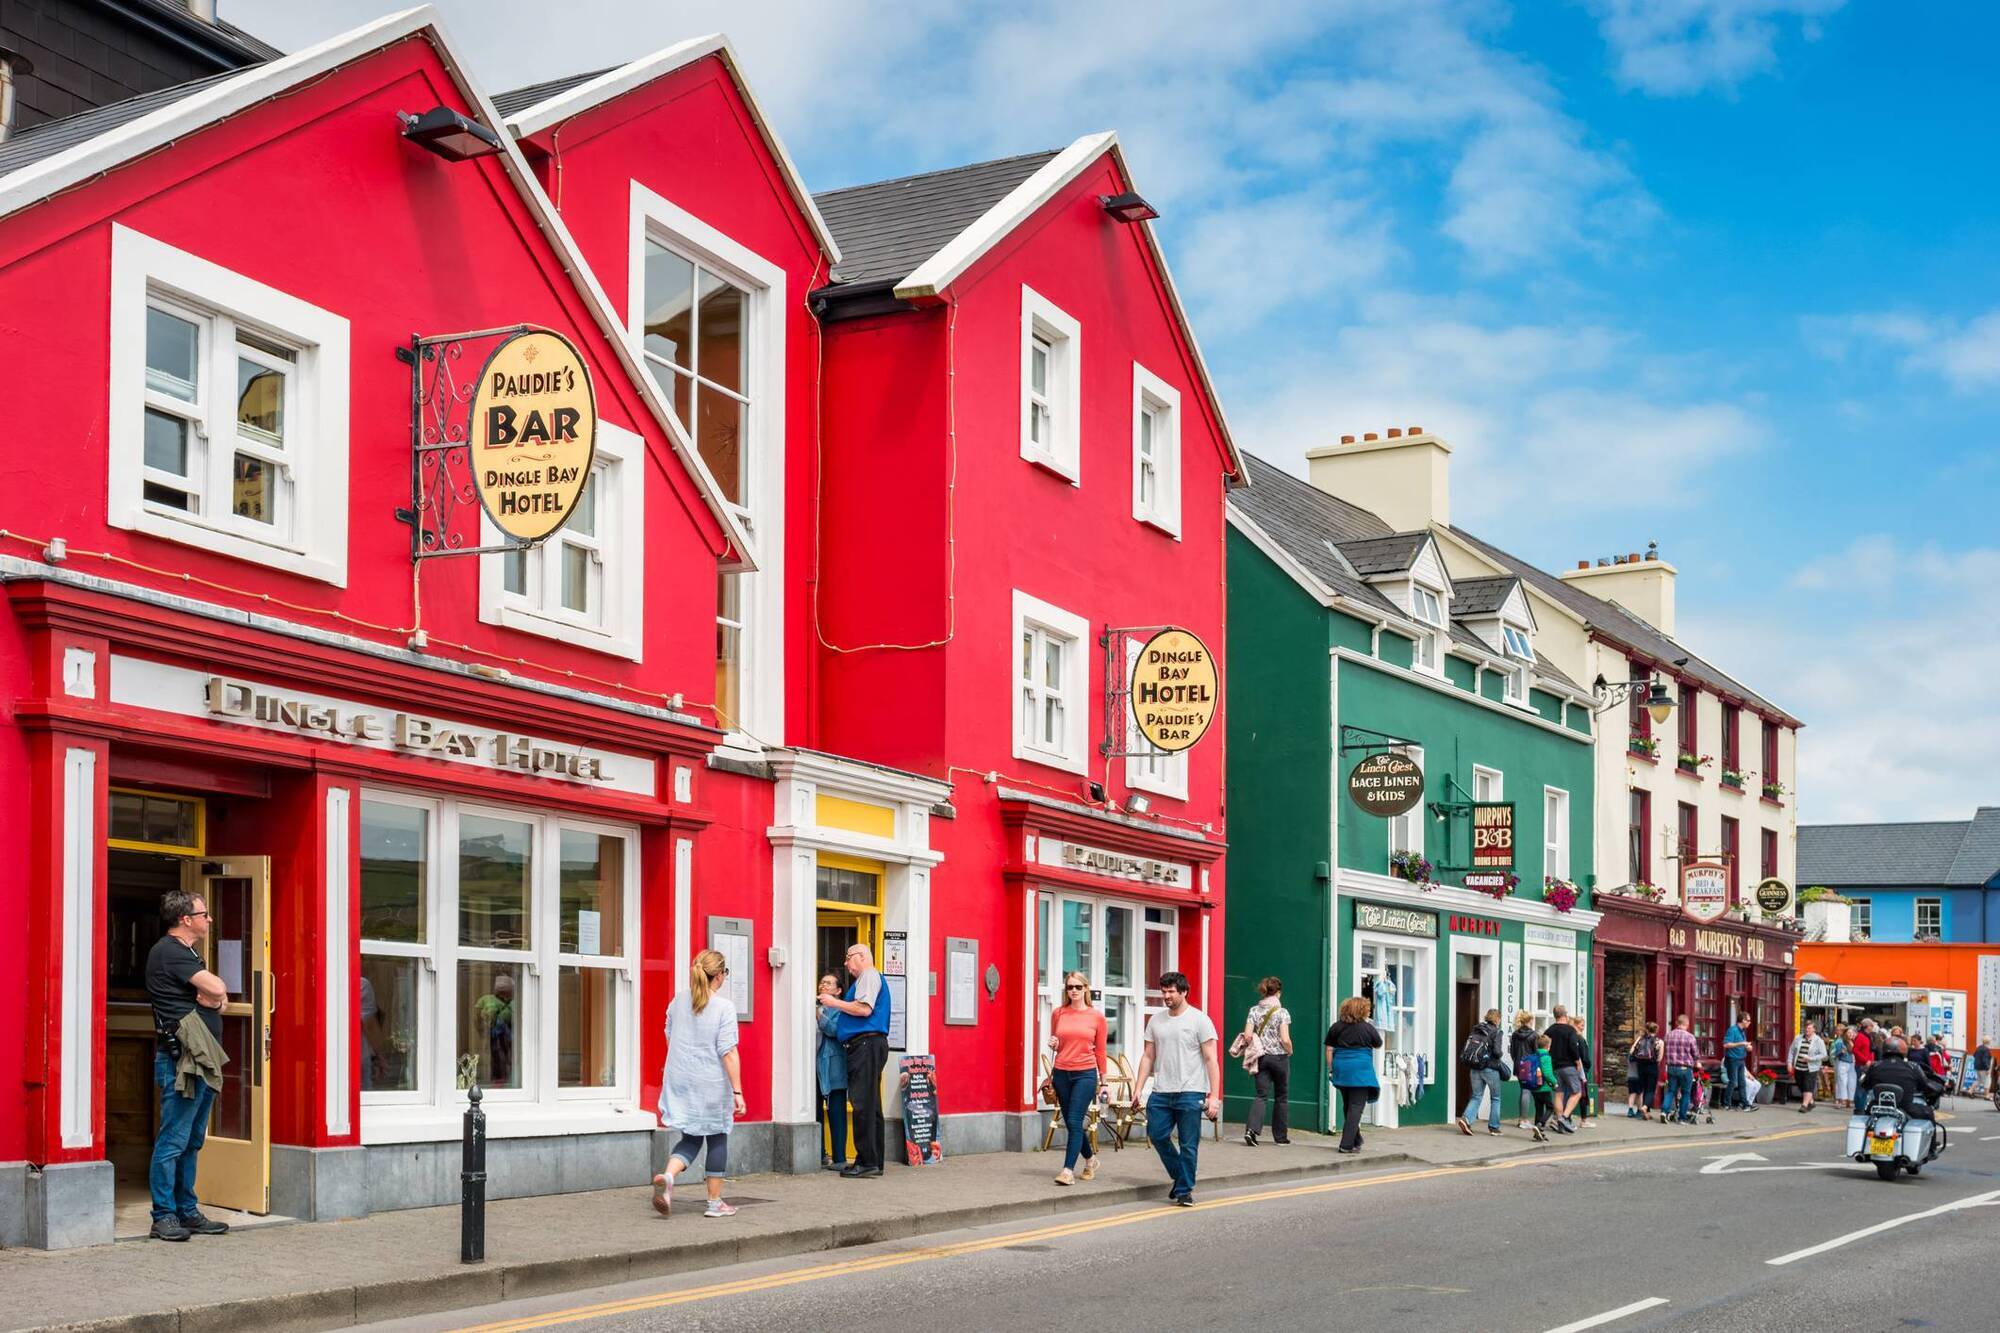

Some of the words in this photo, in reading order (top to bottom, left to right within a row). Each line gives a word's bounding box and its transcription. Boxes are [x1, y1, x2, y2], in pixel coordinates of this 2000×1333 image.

[491, 366, 575, 399] PAUDIE'S
[485, 405, 581, 450] BAR
[485, 469, 541, 489] DINGLE
[546, 466, 579, 486] BAY
[499, 490, 563, 516] HOTEL
[1149, 650, 1202, 665] DINGLE
[1159, 666, 1190, 680] BAY
[1139, 683, 1210, 704] HOTEL
[206, 677, 384, 741] DINGLE
[396, 713, 482, 758] BAY
[1146, 712, 1204, 726] PAUDIE'S
[1160, 728, 1190, 740] BAR
[1360, 763, 1386, 773] Linen
[1388, 760, 1413, 774] Chest
[1351, 777, 1381, 788] LACE
[1384, 776, 1420, 787] LINEN
[1474, 806, 1512, 826] MURPHYS
[1474, 828, 1512, 848] B&B
[1465, 875, 1504, 886] VACANCIES
[1688, 887, 1724, 896] BREAKFAST
[1362, 906, 1381, 927] The
[1382, 909, 1406, 929] Linen
[1407, 912, 1427, 933] Chest
[1449, 914, 1501, 938] MURPHY
[1669, 928, 1686, 947] B&B
[1747, 937, 1764, 961] PUB
[1802, 982, 1817, 1004] FRESH
